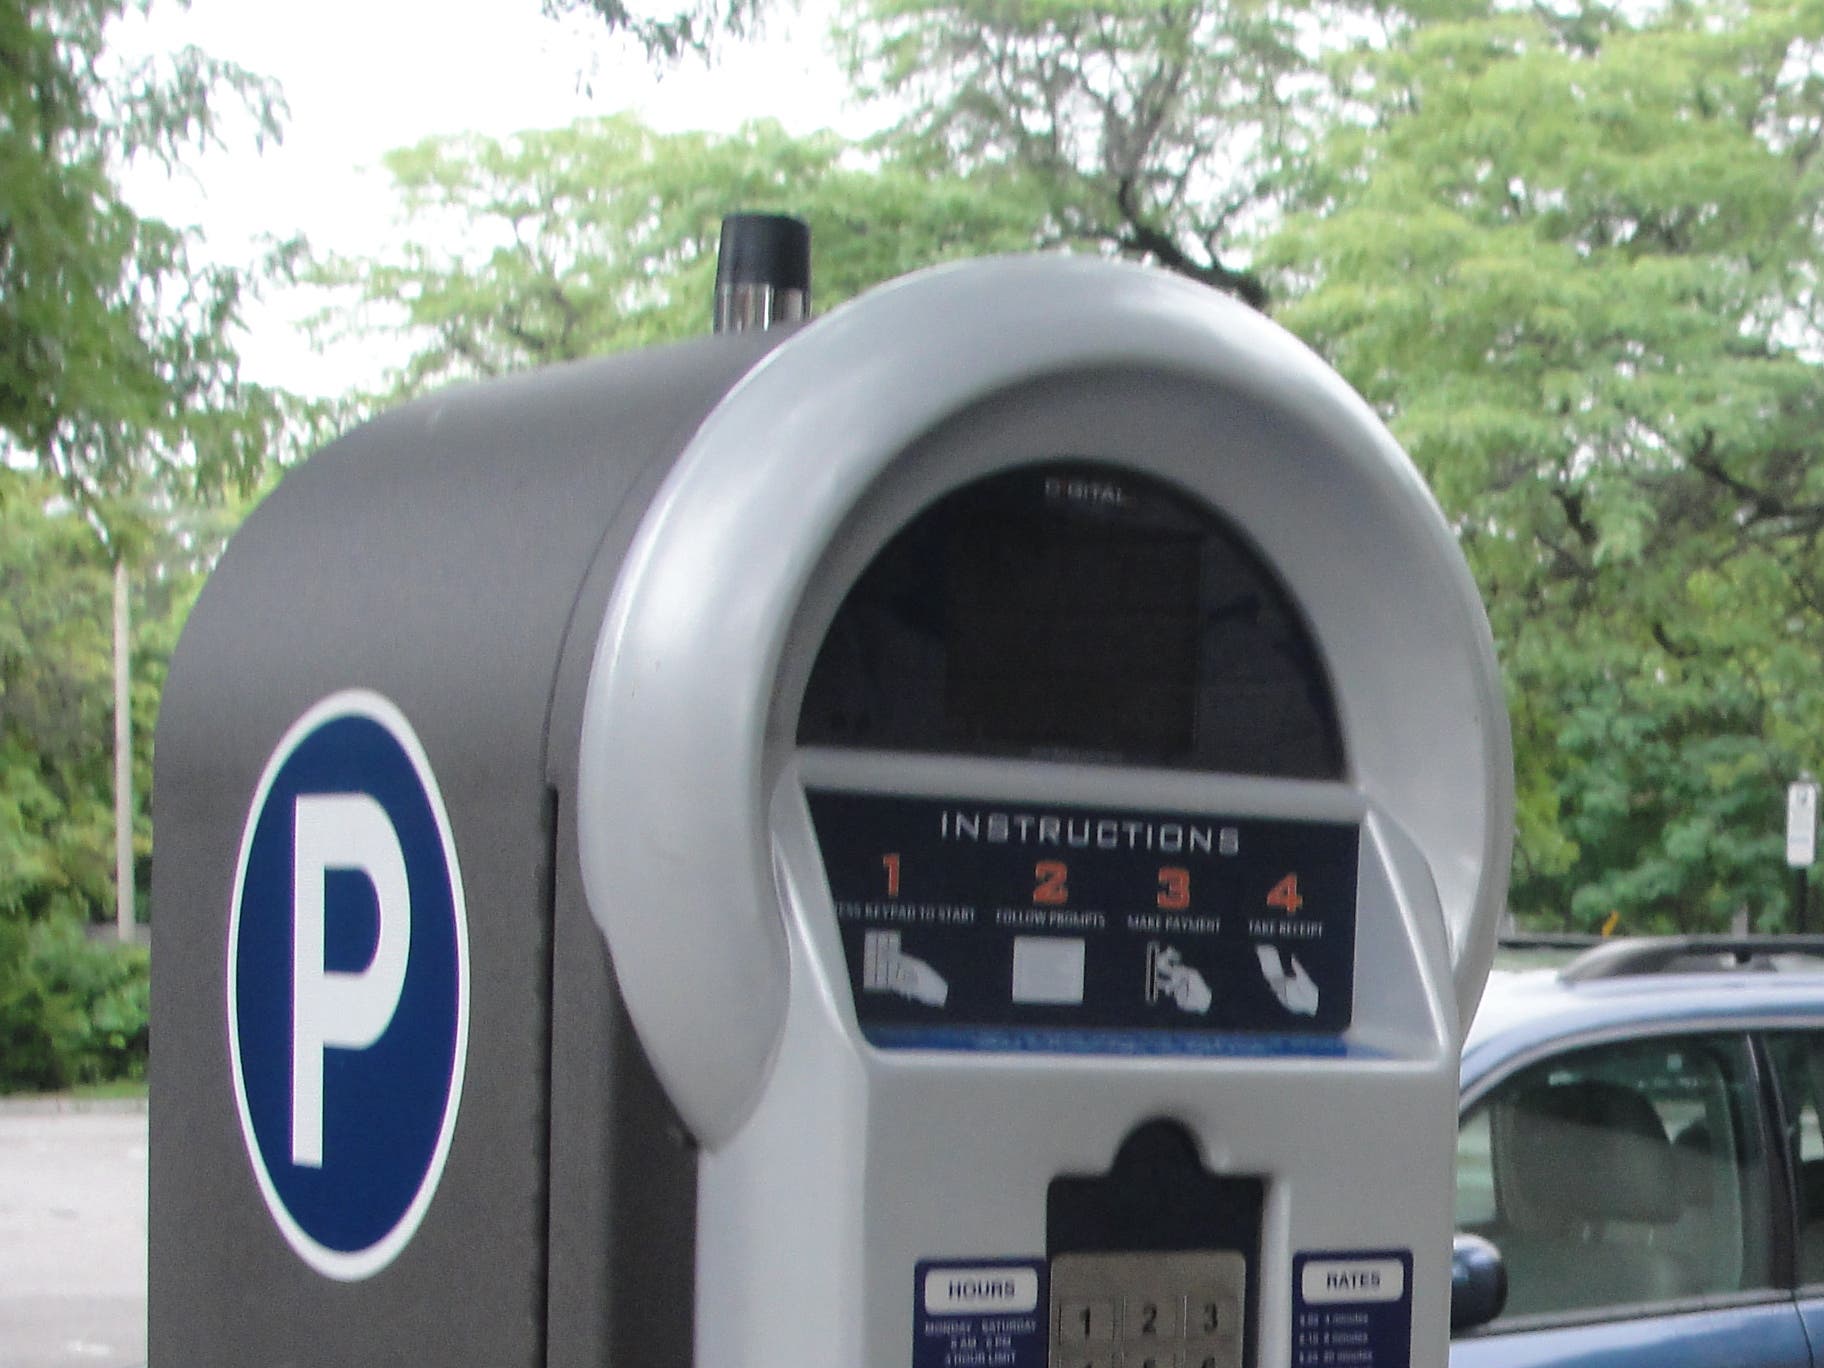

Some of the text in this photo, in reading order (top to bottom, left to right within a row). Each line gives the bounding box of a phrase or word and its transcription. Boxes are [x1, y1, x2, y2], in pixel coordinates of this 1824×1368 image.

[940, 810, 1239, 857] INSTRUCTIONS
[883, 852, 1302, 916] 1 2 3 4
[292, 792, 411, 1169] P
[947, 1279, 1016, 1302] HOURS
[1325, 1269, 1381, 1291] RATES
[1078, 1302, 1219, 1338] 1 2 3
